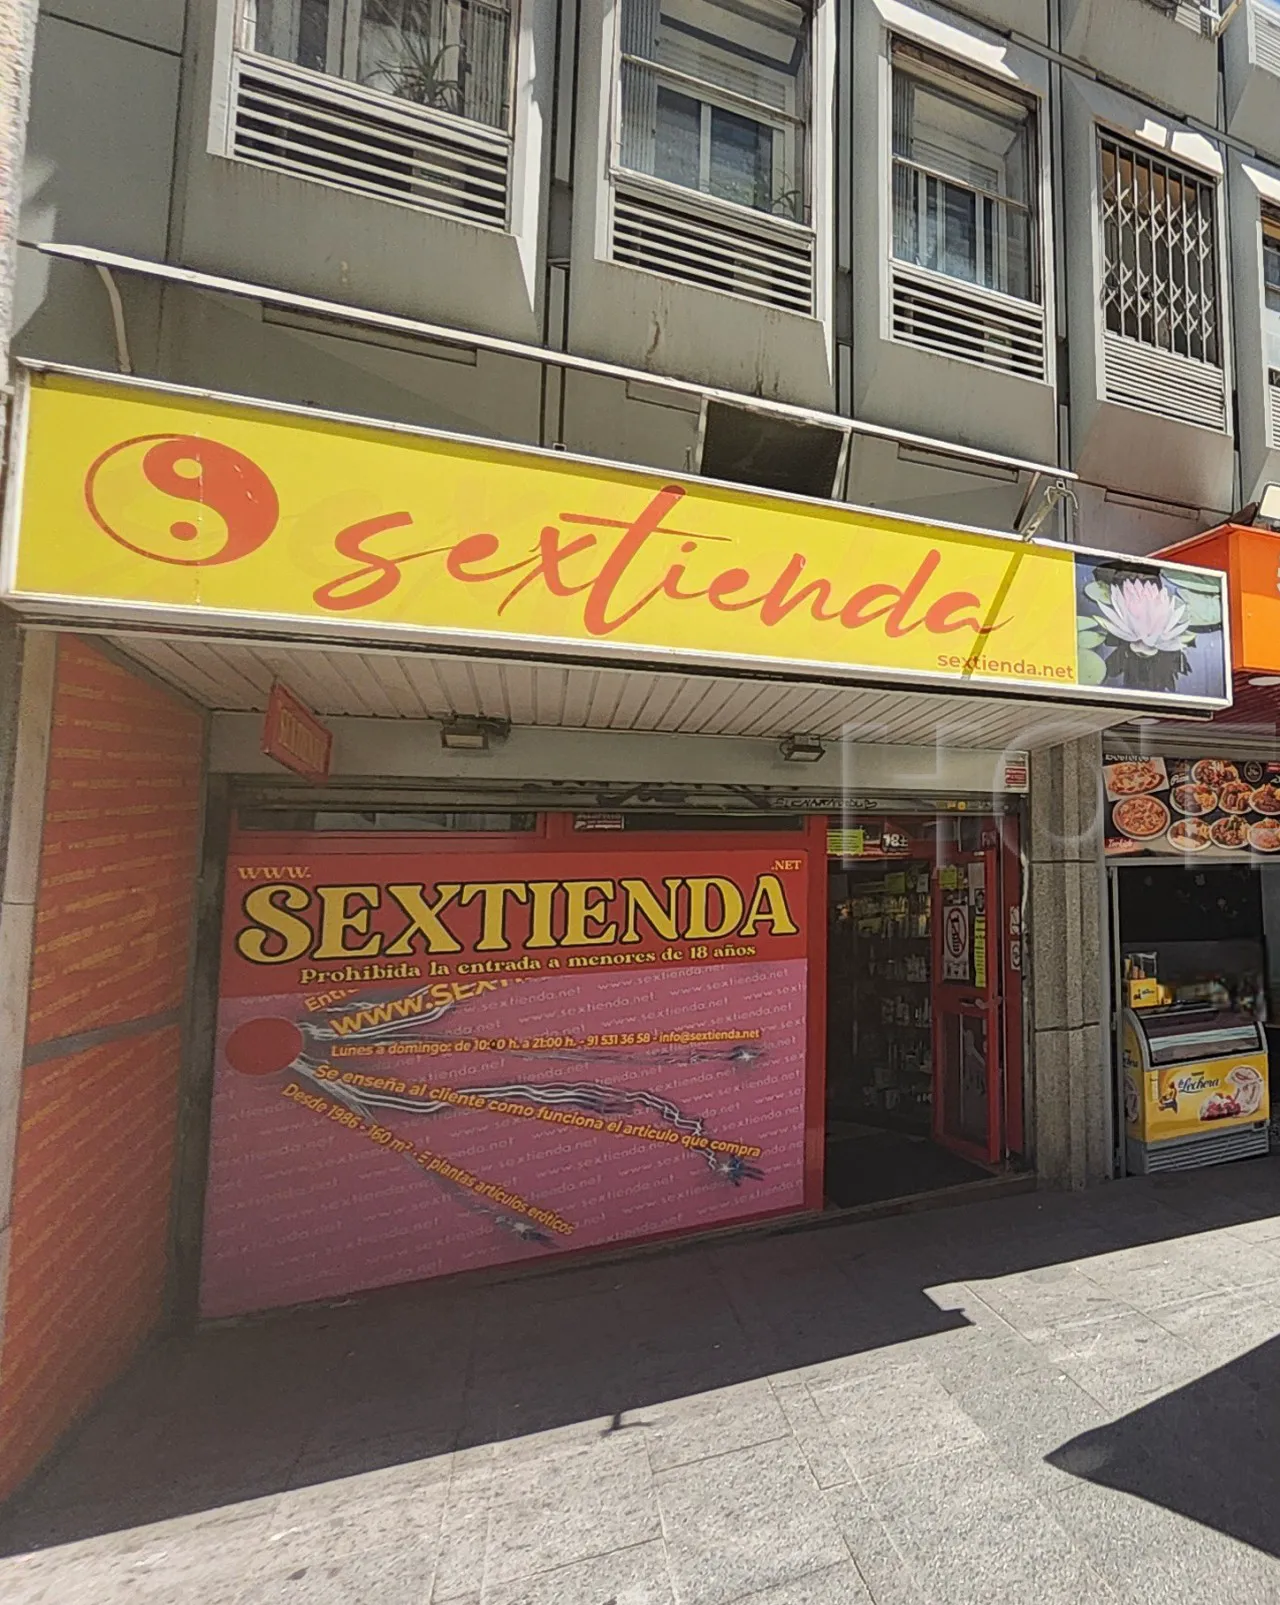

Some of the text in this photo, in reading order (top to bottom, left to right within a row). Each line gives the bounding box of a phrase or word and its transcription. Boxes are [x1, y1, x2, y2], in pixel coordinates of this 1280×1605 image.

[312, 485, 1013, 636] sextienda
[936, 650, 1074, 680] sextienda.net
[771, 859, 802, 872] .NET
[236, 872, 799, 964] SEXTIENDA
[300, 942, 757, 985] Prohibida la entrada a menores de 18 años
[331, 1043, 373, 1057] Lunes
[377, 1045, 386, 1056] a
[387, 1041, 453, 1058] domingo:
[455, 1038, 471, 1052] de
[474, 1039, 507, 1052] 10:0
[508, 1038, 521, 1050] h.
[523, 1041, 531, 1049] a
[532, 1036, 563, 1050] 21:00
[564, 1035, 577, 1048] h.
[587, 1035, 599, 1047] 91
[600, 1034, 619, 1046] 531
[620, 1034, 634, 1045] 36
[636, 1033, 651, 1044] 58
[659, 1028, 760, 1044] info@sextienda.net
[314, 1063, 338, 1081] Se
[340, 1071, 406, 1094] enseña
[408, 1078, 427, 1097] al
[429, 1085, 487, 1109] cliente
[487, 1100, 534, 1118] como
[536, 1104, 604, 1131] funciona
[606, 1119, 623, 1133] el
[681, 1134, 709, 1151] que
[709, 1138, 761, 1158] compra
[281, 1083, 328, 1113] Desde
[327, 1103, 361, 1129] 1986
[367, 1123, 393, 1144] 160
[426, 1156, 478, 1188] plantas
[475, 1180, 529, 1213] artículos
[526, 1208, 576, 1236] eróticos
